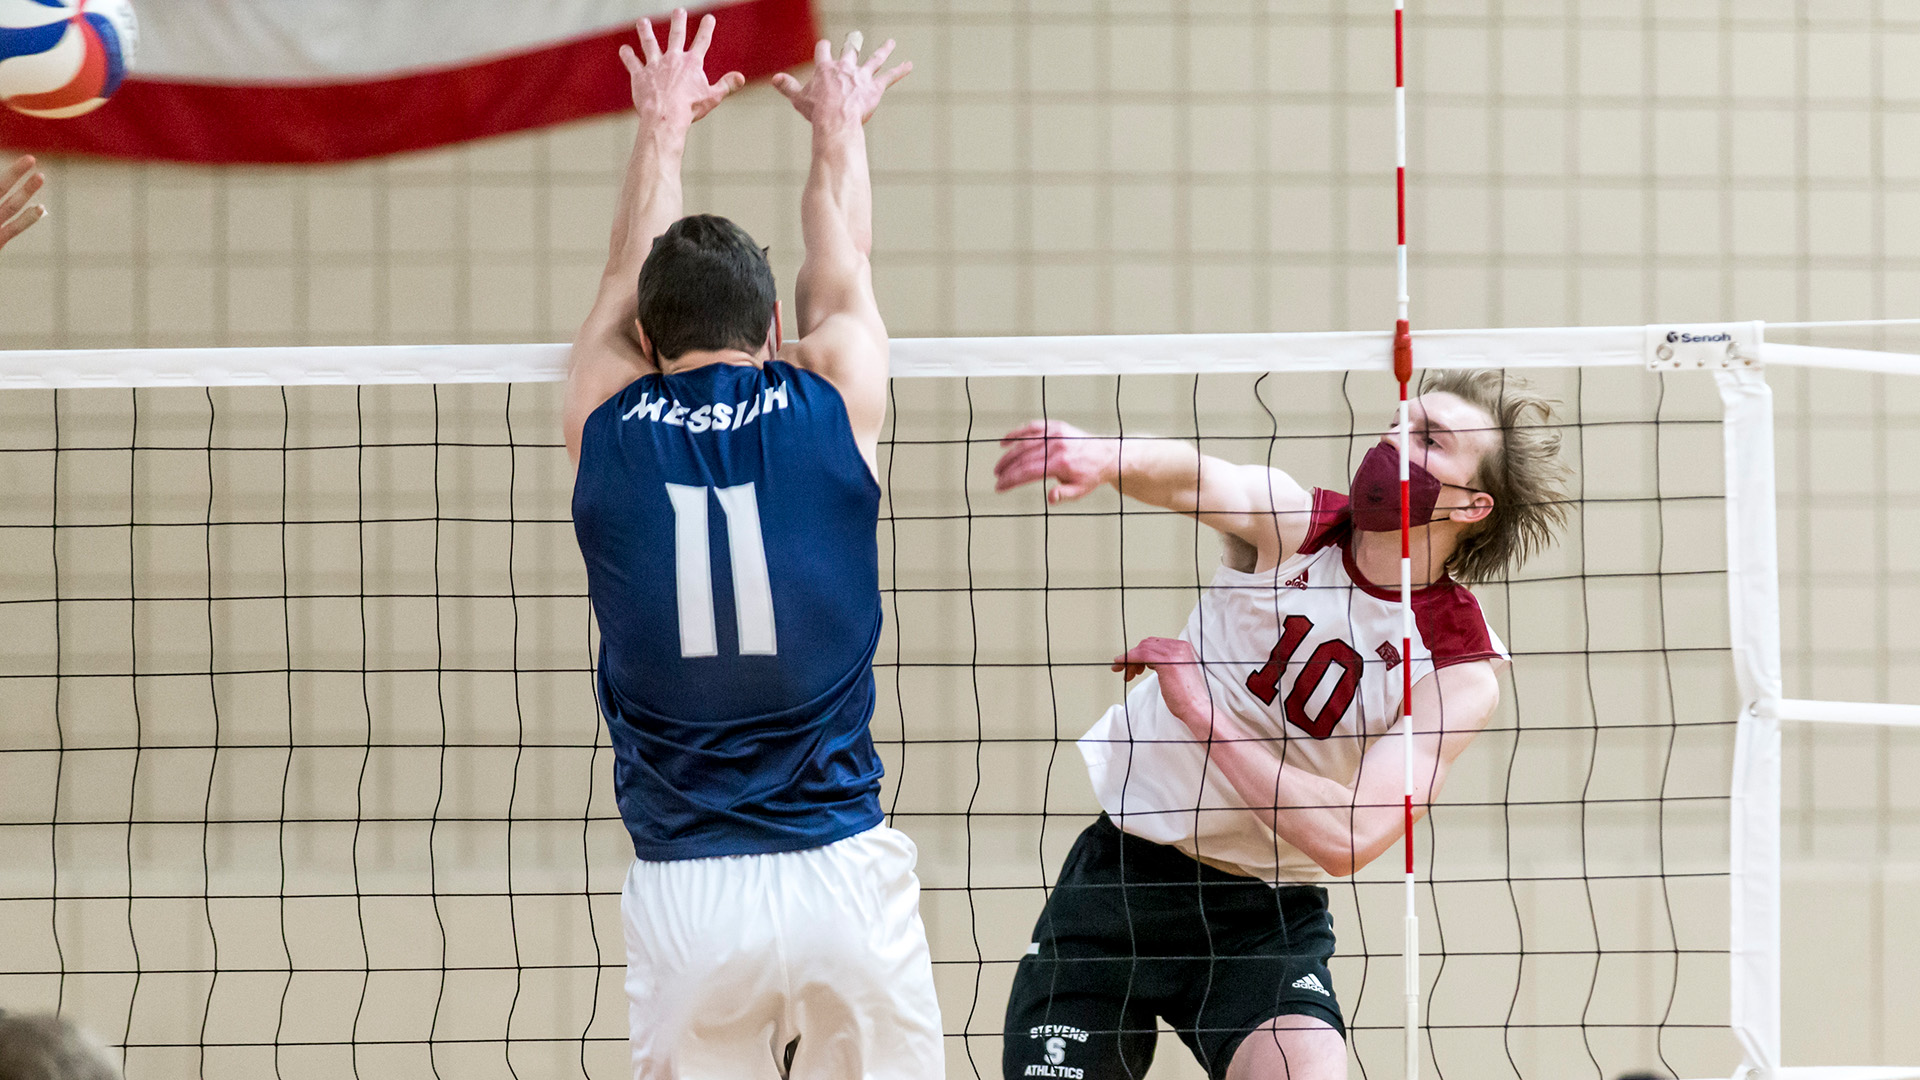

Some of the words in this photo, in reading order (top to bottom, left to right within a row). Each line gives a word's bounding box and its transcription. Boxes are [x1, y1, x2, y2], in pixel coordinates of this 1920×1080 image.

[1682, 332, 1731, 343] Senoh
[665, 482, 777, 658] 11
[1246, 615, 1364, 740] 10
[1030, 1024, 1089, 1042] STEVENS
[1044, 1036, 1066, 1065] S
[1024, 1064, 1084, 1080] ATHLETICS
